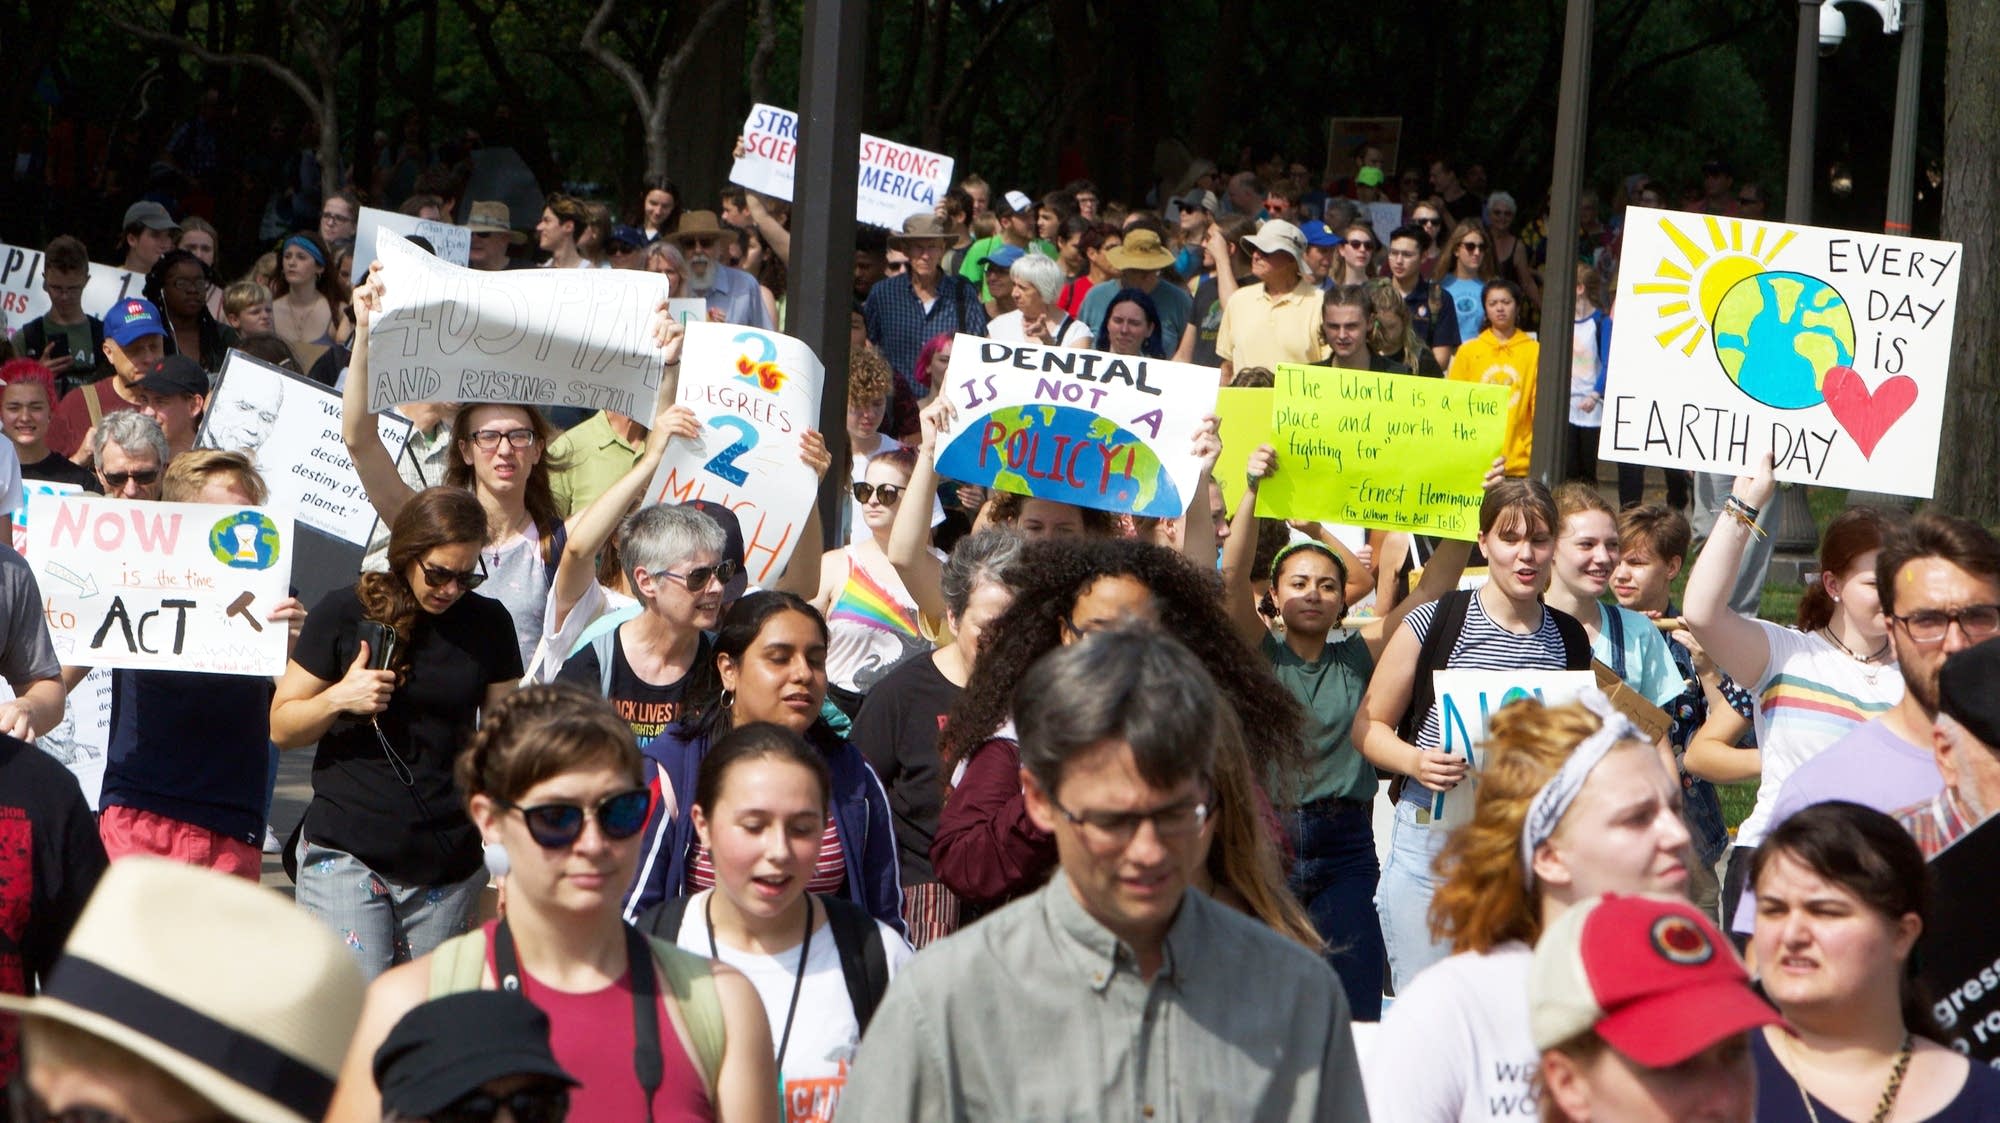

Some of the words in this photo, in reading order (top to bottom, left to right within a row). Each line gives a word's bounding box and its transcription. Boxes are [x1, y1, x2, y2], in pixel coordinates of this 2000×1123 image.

[860, 141, 941, 179] STRONG
[860, 166, 935, 206] MERICA
[1829, 239, 1957, 287] EVERY
[1868, 289, 1945, 330] DAY
[980, 342, 1163, 396] DENIAL
[372, 365, 441, 410] AND
[457, 368, 557, 403] RISING
[563, 381, 635, 418] STILL
[684, 384, 793, 434] DEGREES
[960, 373, 998, 411] IS
[1034, 377, 1109, 409] NOT
[1130, 408, 1164, 440] A
[1412, 387, 1426, 407] is
[1441, 394, 1452, 412] a
[1468, 389, 1499, 418] fine
[1276, 407, 1320, 435] place
[1338, 412, 1371, 433] and
[1387, 418, 1435, 437] worth
[1452, 422, 1478, 441] the
[1613, 396, 1750, 466] EARTH
[1772, 422, 1837, 480] DAY
[310, 446, 355, 472] decide
[703, 415, 760, 488] 2
[979, 420, 1136, 501] POLICY!
[1289, 431, 1343, 474] fighting
[291, 463, 341, 491] destiny
[342, 483, 358, 499] of
[1419, 482, 1483, 515] Hemingwa
[49, 501, 183, 556] NOW
[1395, 510, 1409, 523] the
[1412, 512, 1429, 525] Bell
[122, 562, 142, 585] is
[154, 569, 177, 585] the
[184, 567, 215, 588] time
[43, 596, 76, 630] to
[613, 700, 638, 720] ACK
[639, 701, 673, 722] LIVES
